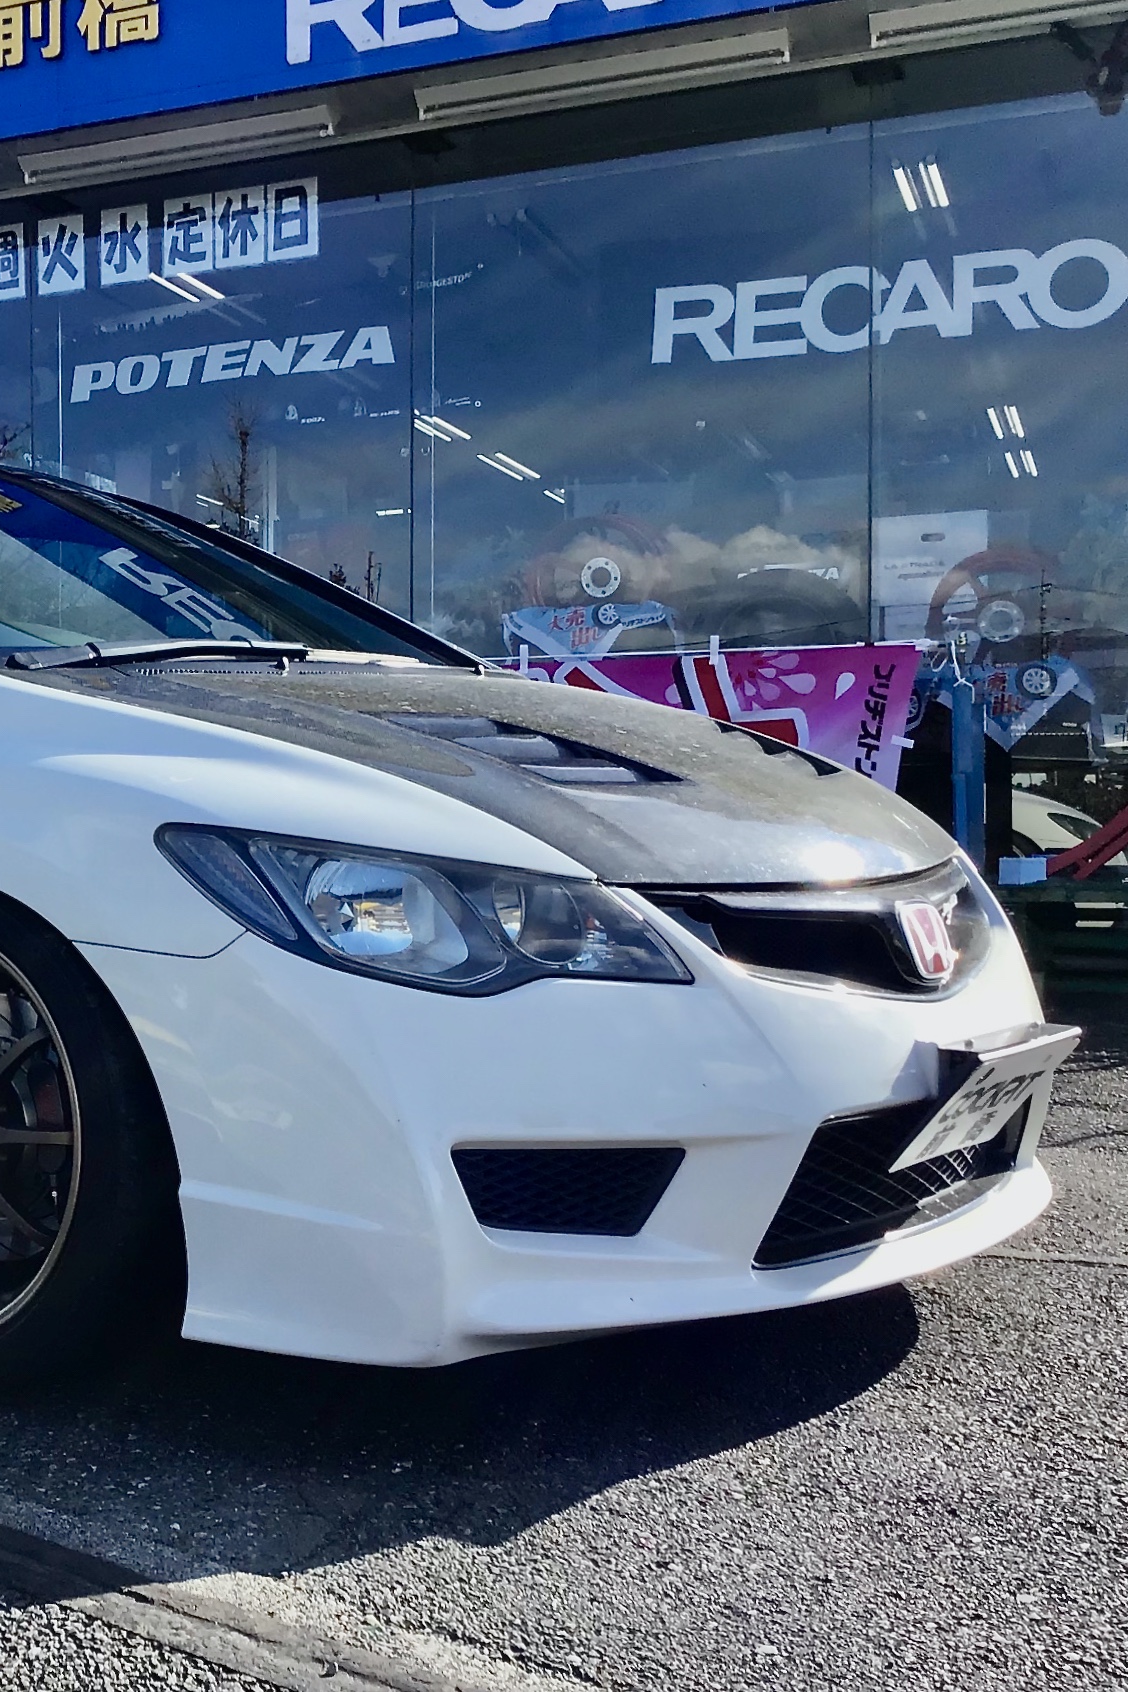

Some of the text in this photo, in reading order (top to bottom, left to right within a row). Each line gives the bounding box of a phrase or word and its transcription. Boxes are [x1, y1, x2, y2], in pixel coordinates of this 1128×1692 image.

[41, 223, 79, 285] 火
[103, 212, 142, 275] 水
[166, 185, 310, 266] 定休日
[650, 238, 1128, 365] RECARO
[70, 325, 395, 403] POTENZA
